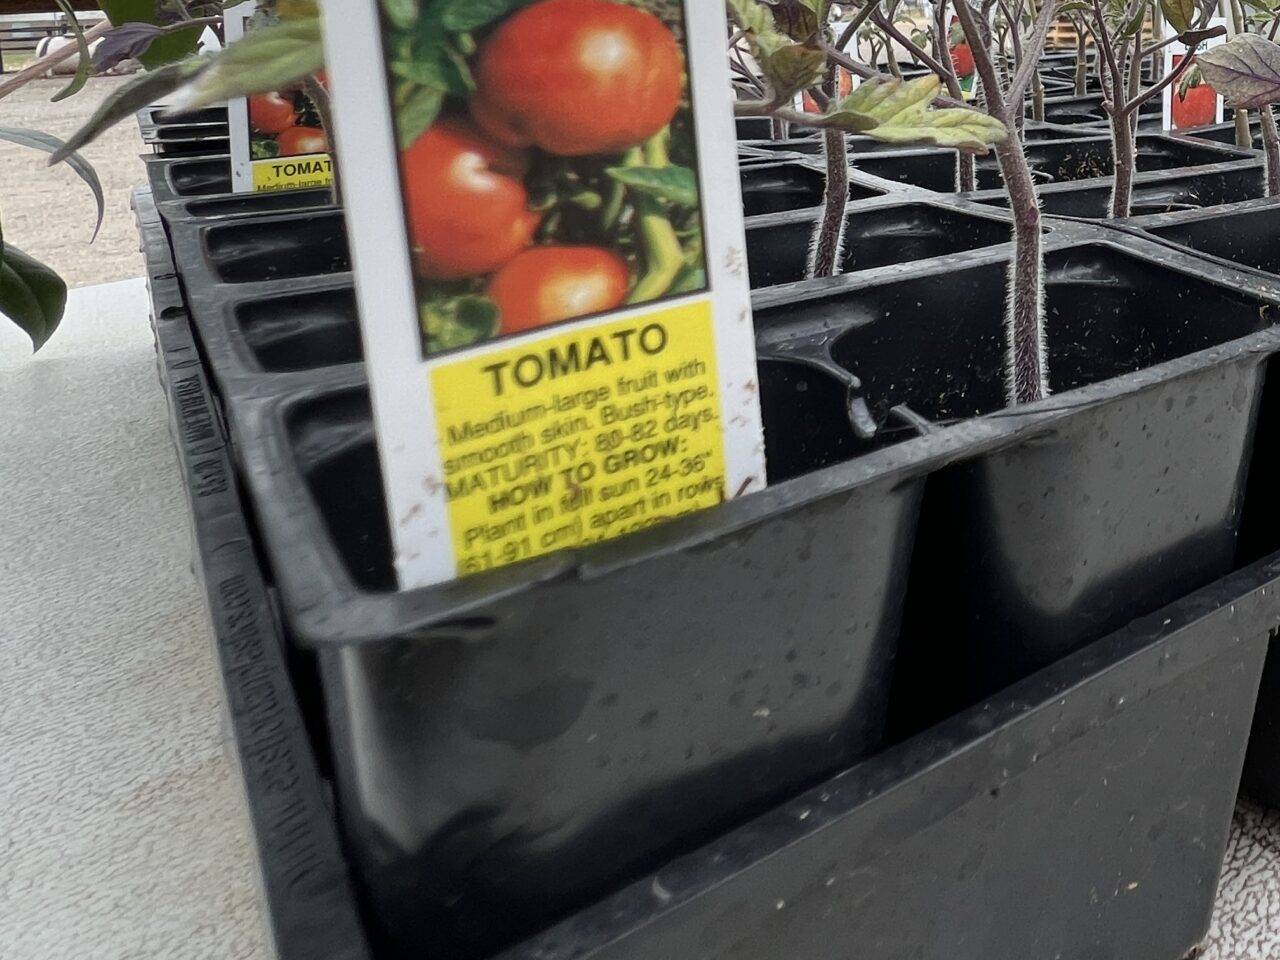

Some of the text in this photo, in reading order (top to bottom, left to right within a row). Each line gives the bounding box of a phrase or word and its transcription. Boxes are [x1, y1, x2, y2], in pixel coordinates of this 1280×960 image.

[272, 160, 332, 178] TOMAT
[482, 323, 668, 397] TOMATO
[444, 384, 714, 476] smooth skin. Bush-type.
[448, 359, 706, 446] Medium-large fruit with
[445, 406, 719, 501] MATURITY: 80-82 days.
[487, 437, 689, 515] HOW TO GROW:
[464, 511, 526, 549] Plant
[532, 505, 555, 525] in
[599, 476, 640, 502] sun
[589, 497, 647, 530] apart
[651, 489, 673, 511] in
